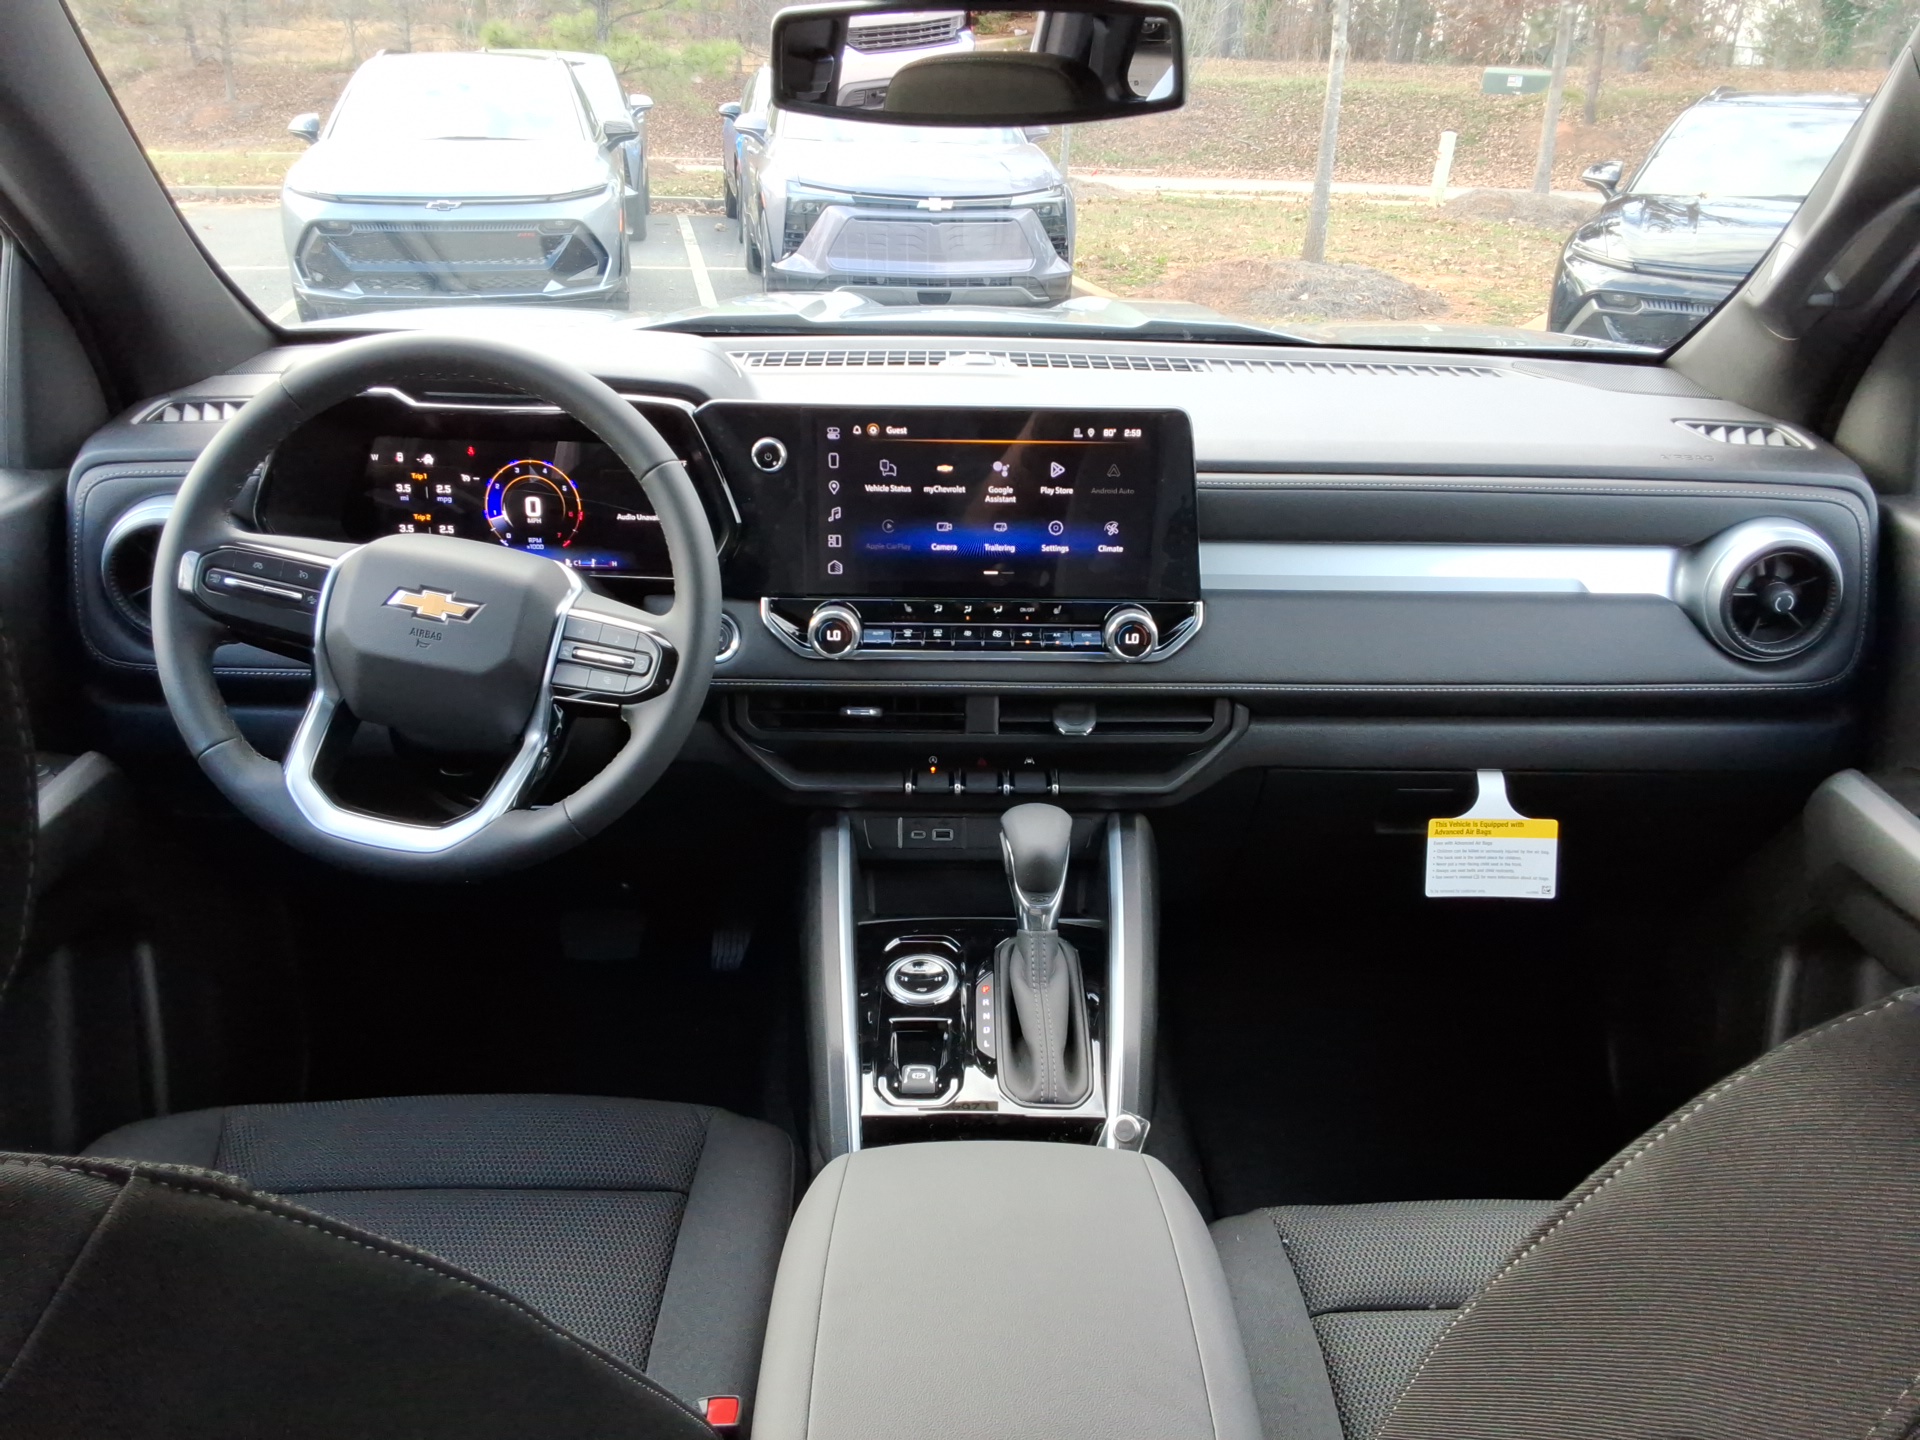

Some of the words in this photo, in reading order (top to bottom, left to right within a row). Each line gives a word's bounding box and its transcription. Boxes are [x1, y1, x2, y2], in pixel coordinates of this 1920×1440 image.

[886, 426, 908, 435] Guest
[396, 484, 411, 493] 3.5
[436, 485, 451, 493] 2.5
[890, 484, 912, 493] Status
[924, 485, 966, 494] myChevrolet
[988, 486, 1013, 495] Google
[1040, 486, 1054, 496] Play
[525, 496, 541, 517] 0
[399, 524, 414, 532] 3.5
[439, 525, 454, 534] 2.5
[984, 544, 1015, 553] Trailering
[1041, 544, 1069, 553] Settings
[409, 628, 442, 641] AIRBAG
[982, 985, 990, 994] P
